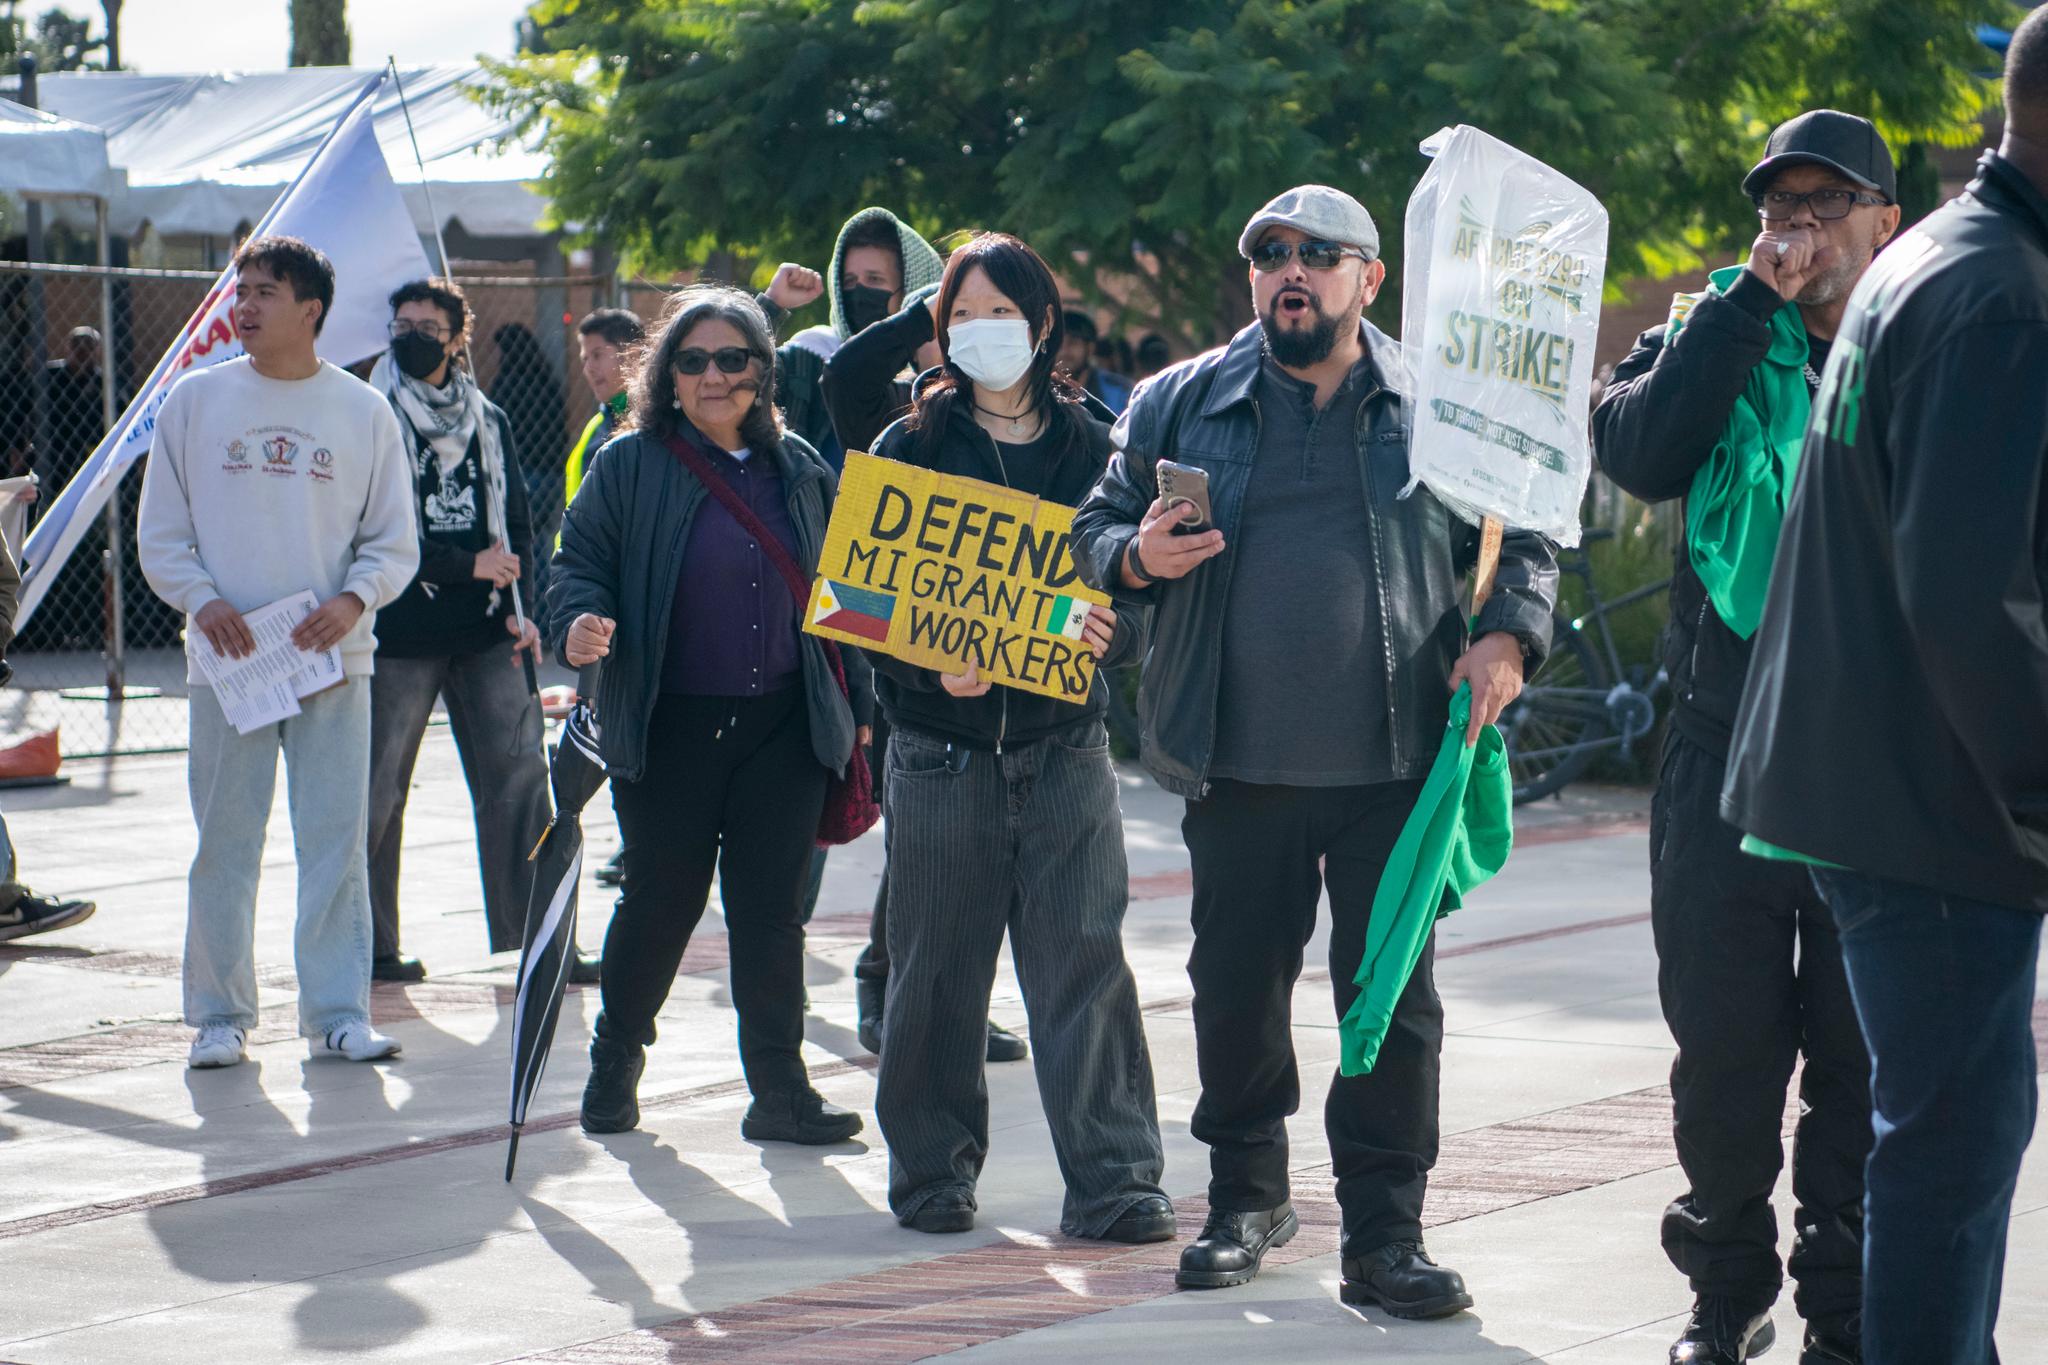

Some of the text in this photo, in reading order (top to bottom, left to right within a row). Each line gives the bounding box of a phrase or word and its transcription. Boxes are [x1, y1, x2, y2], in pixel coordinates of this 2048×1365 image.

[1453, 228, 1534, 273] AFCME
[1502, 280, 1534, 320] ON
[1442, 310, 1575, 393] STRIKE!
[1443, 403, 1455, 419] TO
[1486, 422, 1505, 440] NOT
[1504, 428, 1521, 449] JUST
[869, 484, 1079, 588] DEFEND
[842, 540, 1054, 631] MIGRANT
[907, 605, 1095, 695] WORKERS
